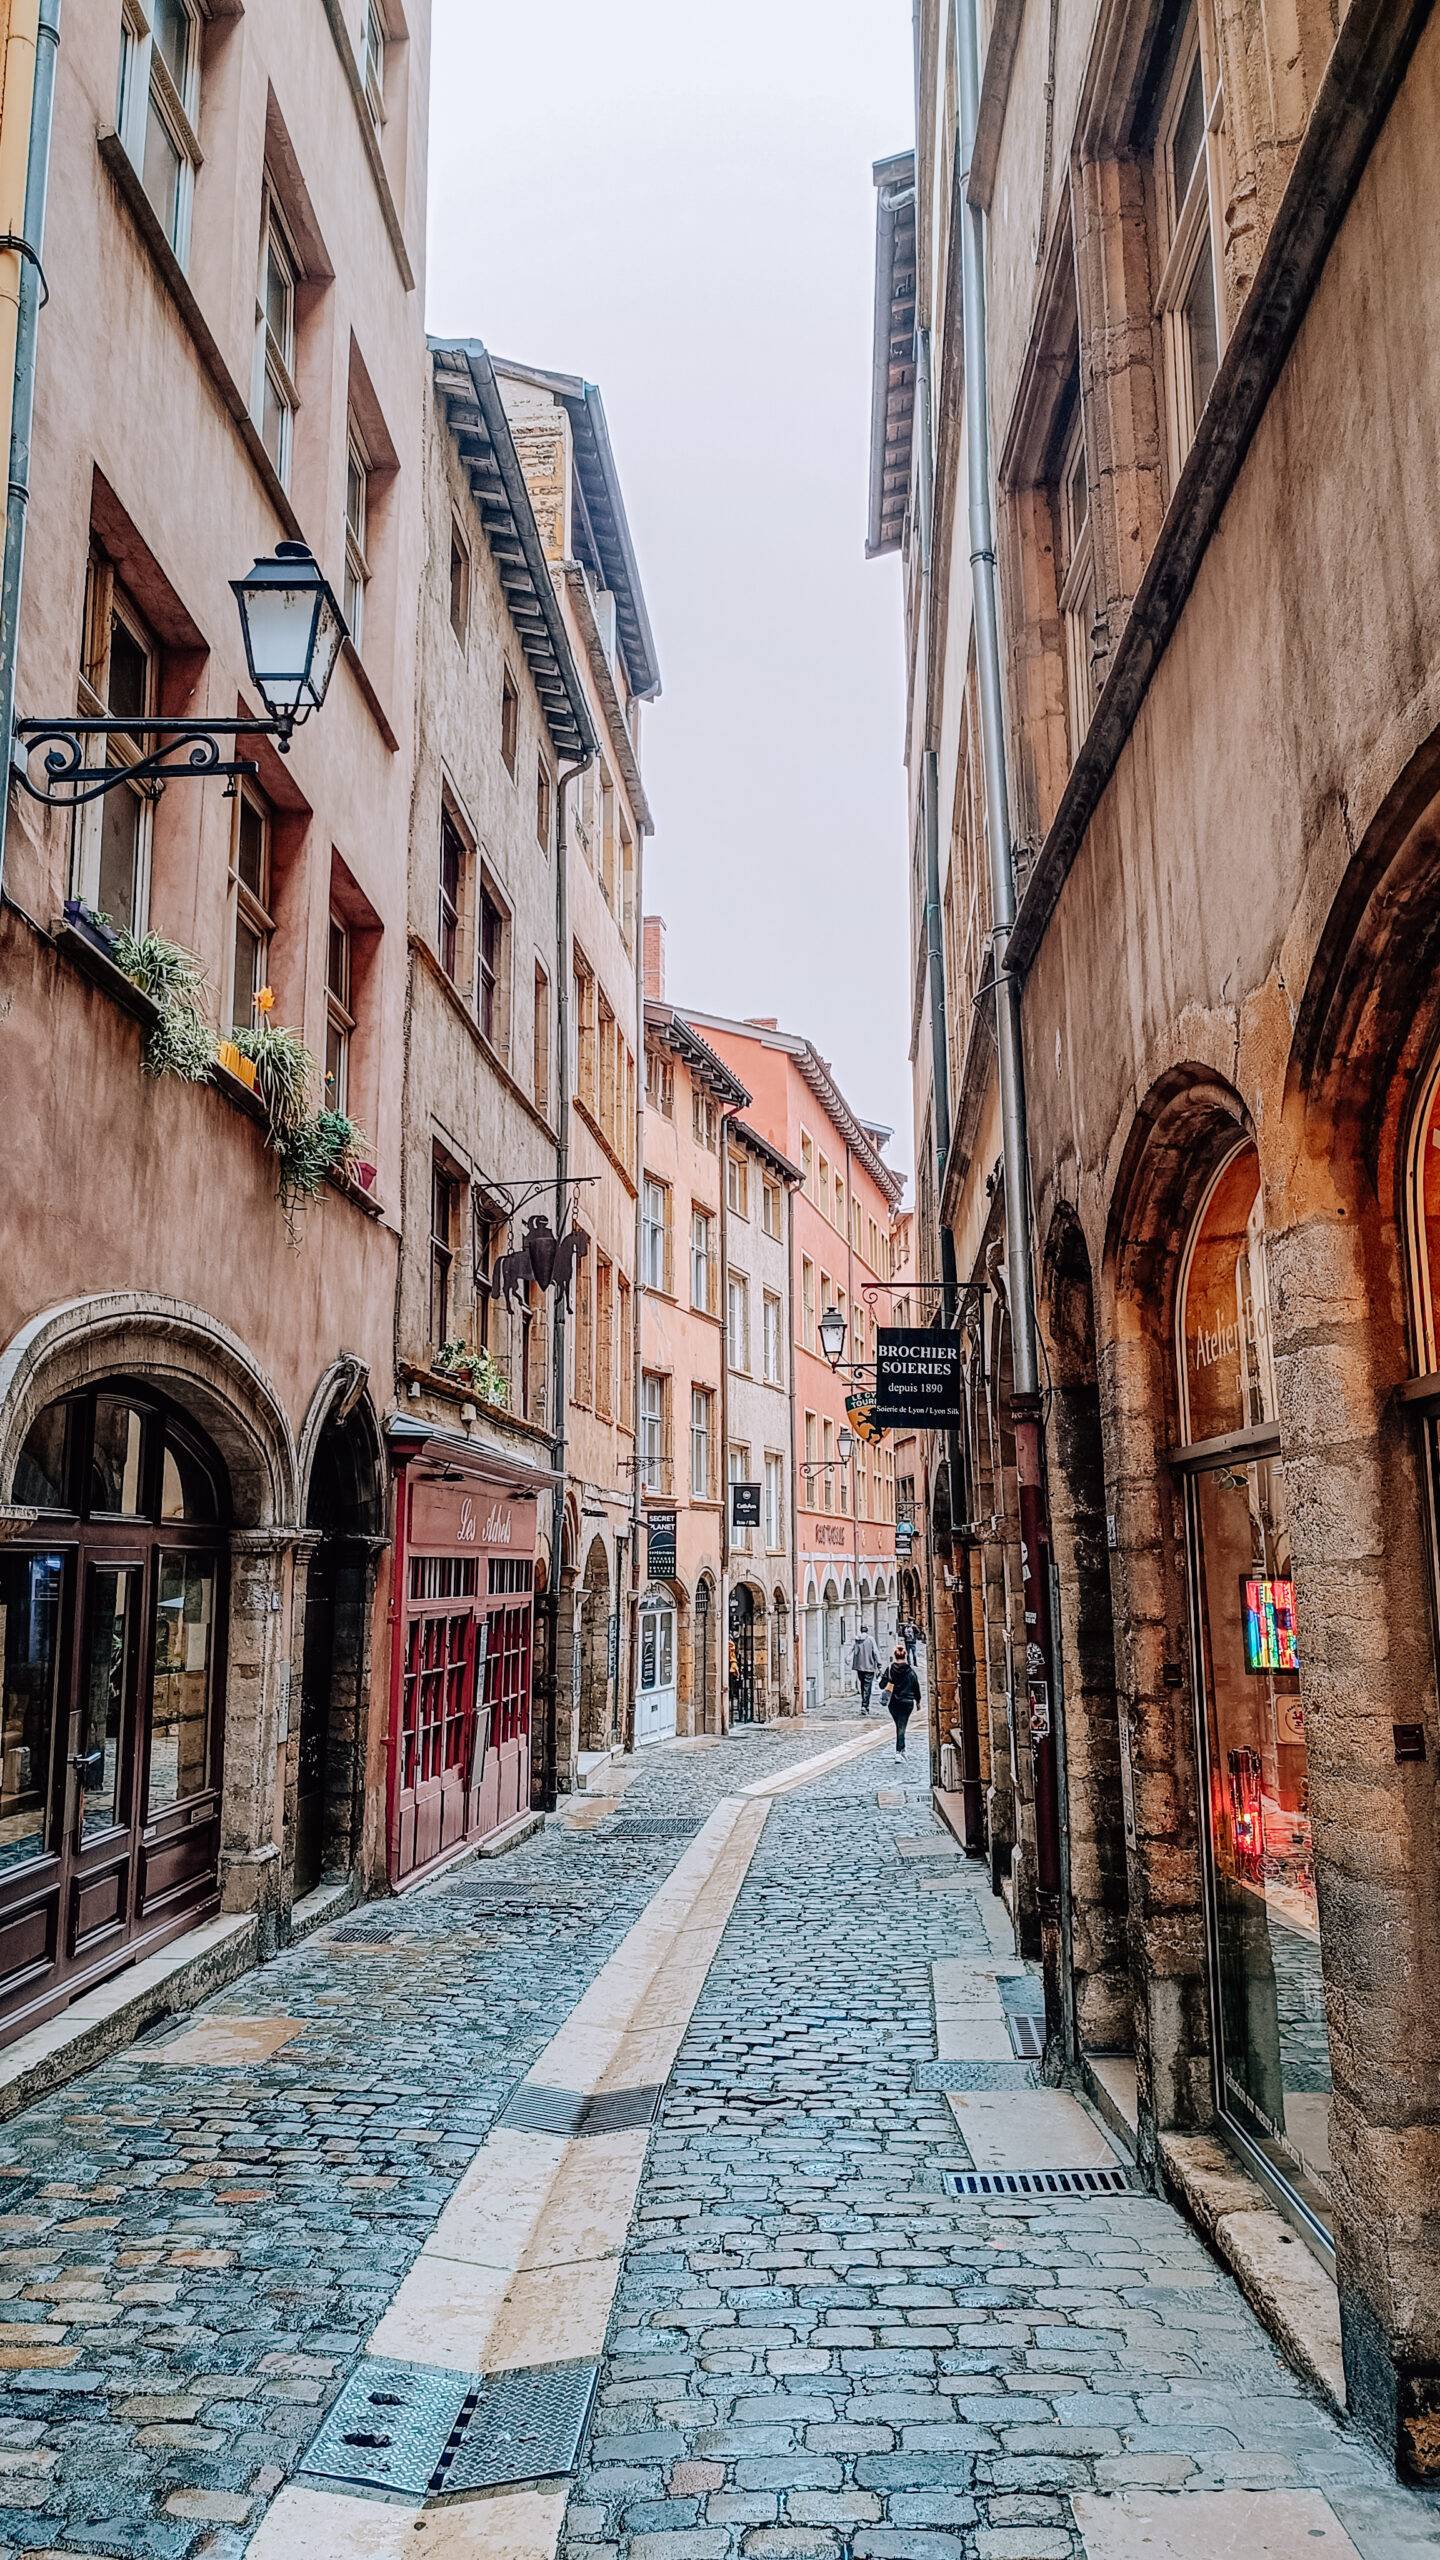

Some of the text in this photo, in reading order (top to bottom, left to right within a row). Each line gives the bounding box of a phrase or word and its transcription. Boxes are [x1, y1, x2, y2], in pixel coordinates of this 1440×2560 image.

[1196, 1308, 1240, 1371] Atelier
[878, 1345, 958, 1360] BROCHIER
[882, 1361, 952, 1376] SOIERIES
[888, 1382, 944, 1395] depuis 1890
[851, 1391, 877, 1402] LE CY
[876, 1405, 898, 1413] Soierie
[899, 1405, 907, 1413] de
[908, 1406, 925, 1415] Lyon
[929, 1407, 946, 1416] Lyon
[947, 1407, 960, 1415] Silk
[456, 1497, 477, 1541] Les
[650, 1523, 675, 1531] PLANET
